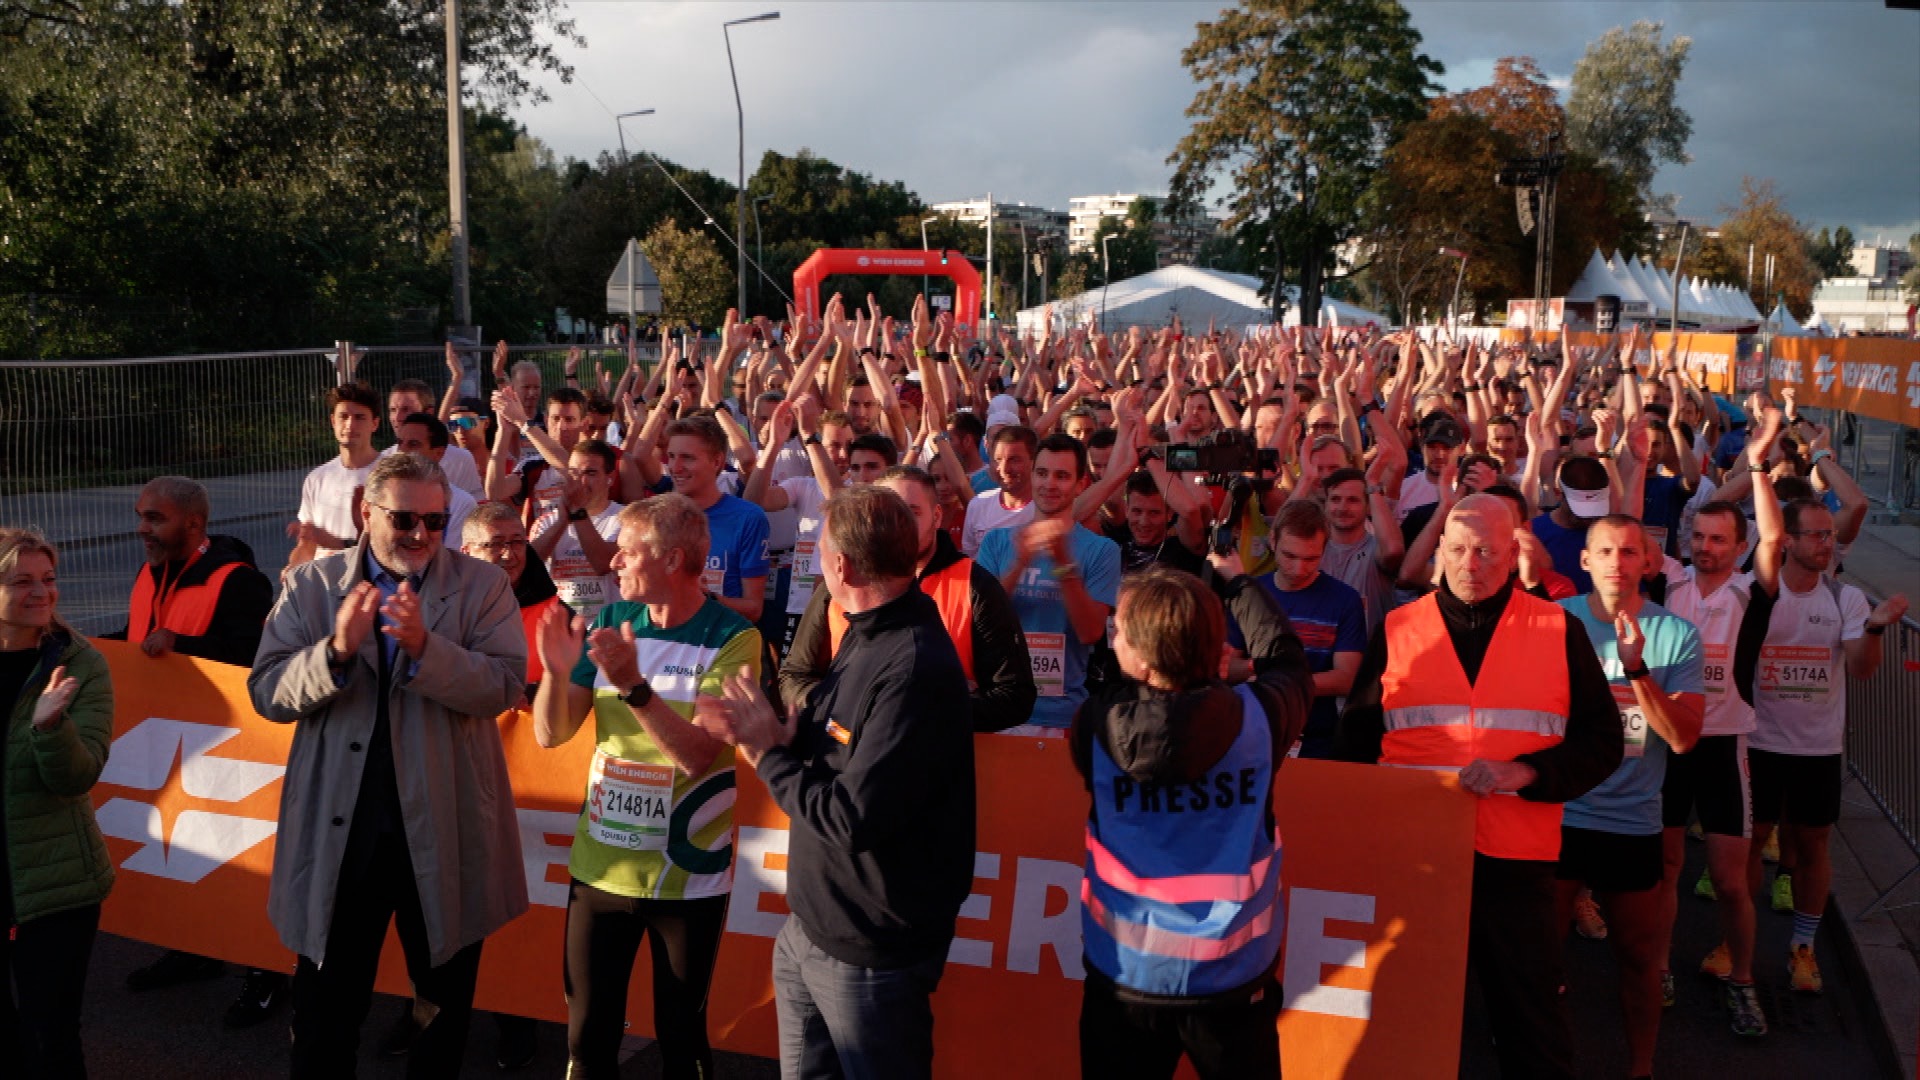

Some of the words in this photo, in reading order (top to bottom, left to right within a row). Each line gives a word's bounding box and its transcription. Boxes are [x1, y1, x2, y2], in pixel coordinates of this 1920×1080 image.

[1704, 666, 1725, 680] 9B
[1783, 666, 1829, 682] 5174A
[606, 763, 627, 775] WIEN
[628, 768, 668, 781] ENERGIE
[1113, 767, 1257, 813] PRESSE
[606, 789, 667, 819] 21481A
[600, 829, 627, 842] spusu
